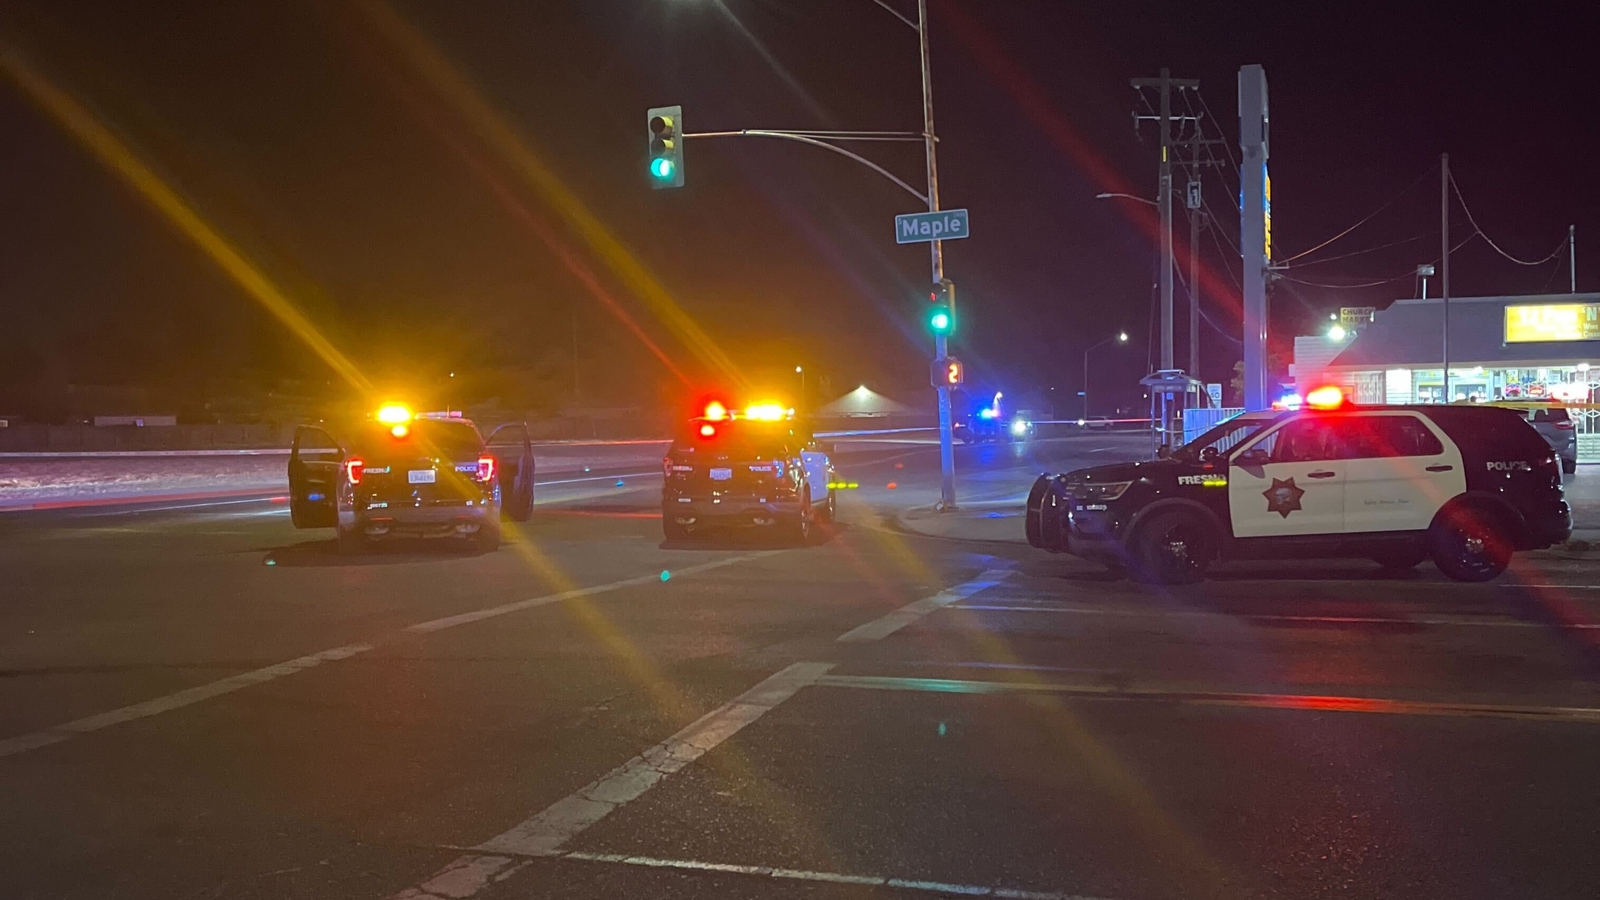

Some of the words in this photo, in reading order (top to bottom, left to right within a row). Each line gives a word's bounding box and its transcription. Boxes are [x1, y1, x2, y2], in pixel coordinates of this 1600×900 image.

[902, 215, 961, 237] Maple
[948, 363, 958, 383] 2
[1486, 461, 1528, 471] POLICE
